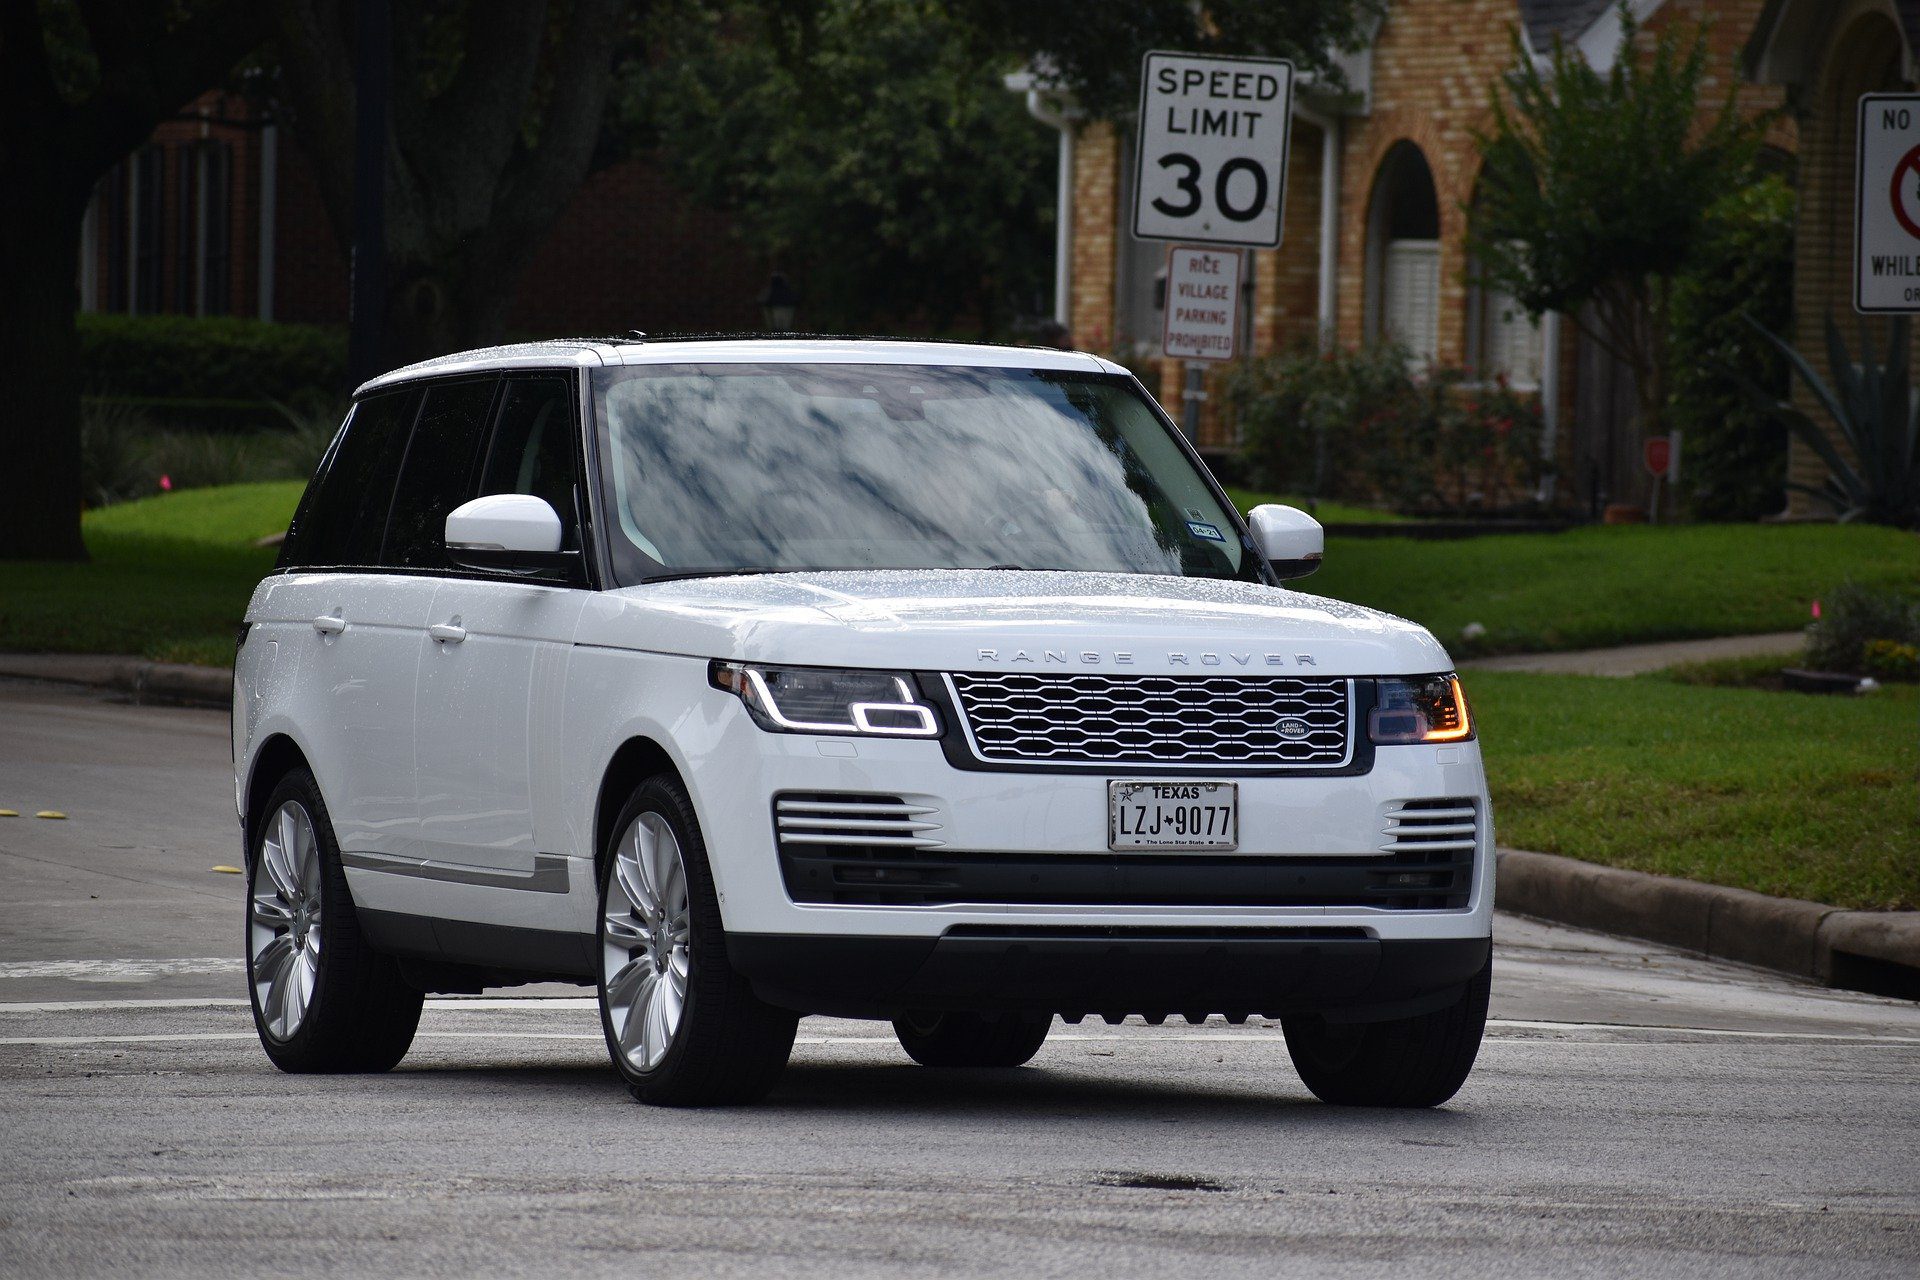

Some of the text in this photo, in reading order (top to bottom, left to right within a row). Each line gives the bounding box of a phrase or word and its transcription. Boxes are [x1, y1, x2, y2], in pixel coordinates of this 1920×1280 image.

[1156, 67, 1278, 102] SPEED
[1167, 106, 1262, 139] LIMIT
[1882, 109, 1910, 130] NO
[1151, 152, 1268, 222] 30
[1188, 257, 1220, 275] RICE
[1178, 283, 1229, 301] VILLAGE
[1175, 307, 1227, 326] PARKING
[1168, 332, 1231, 351] PROHIBITED
[976, 648, 1318, 666] RANGE ROVER
[1152, 786, 1200, 799] TEXAS
